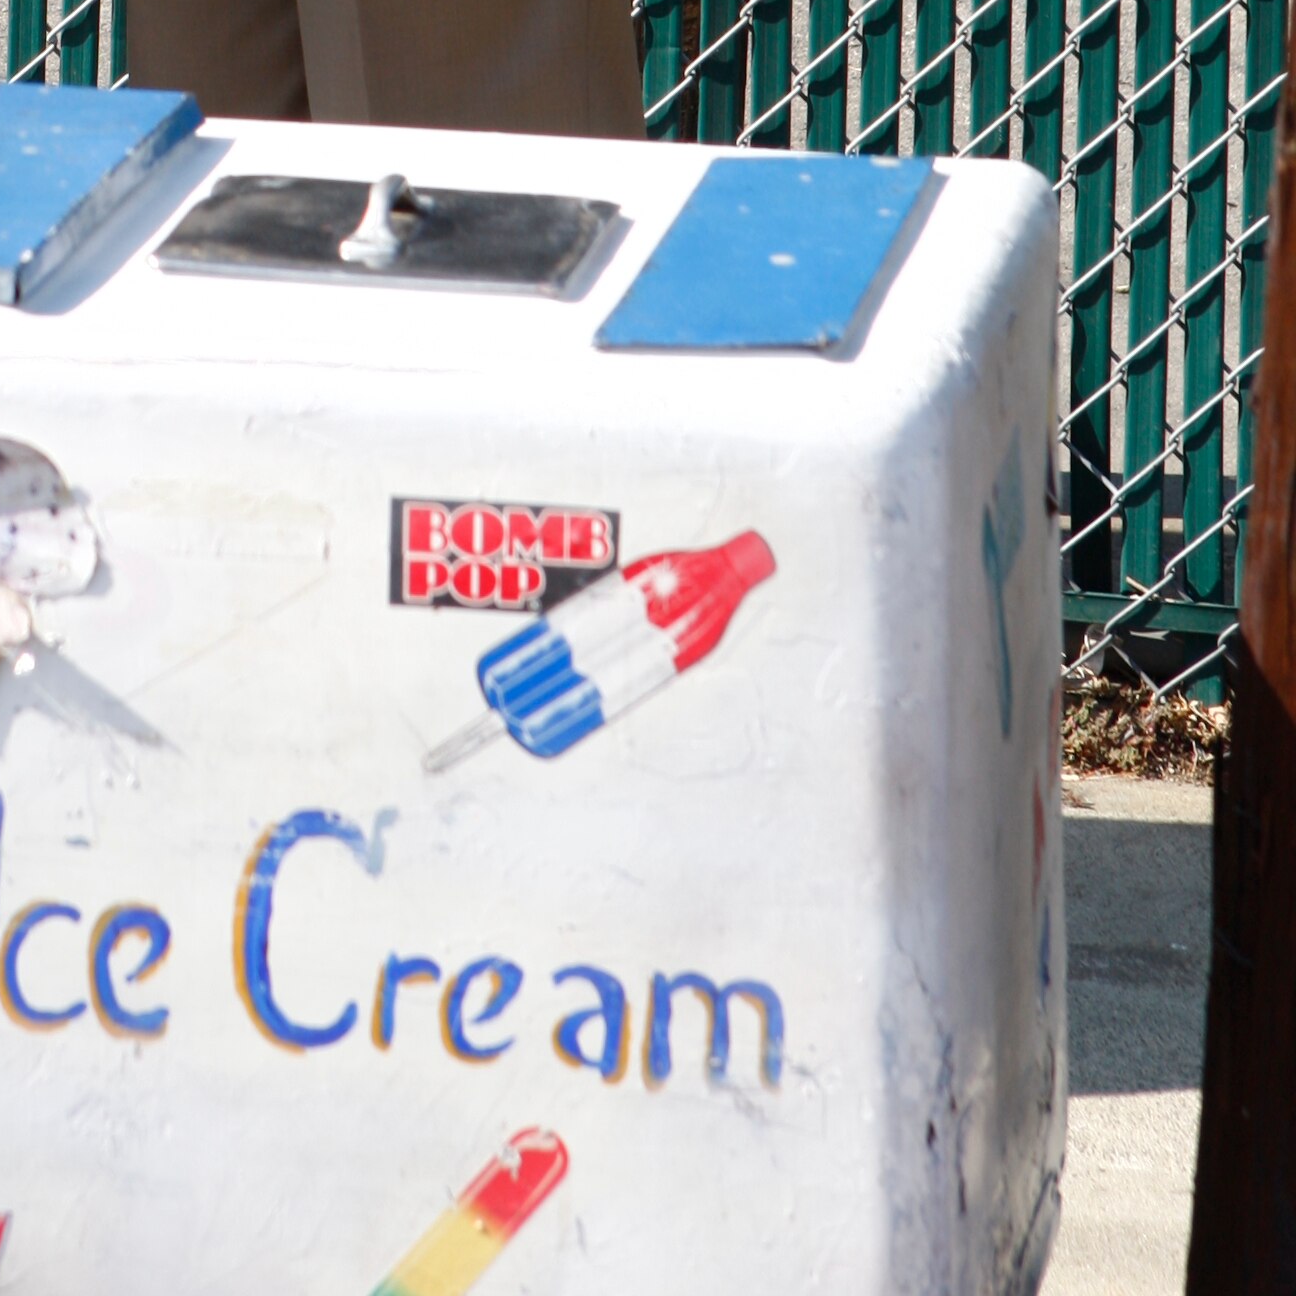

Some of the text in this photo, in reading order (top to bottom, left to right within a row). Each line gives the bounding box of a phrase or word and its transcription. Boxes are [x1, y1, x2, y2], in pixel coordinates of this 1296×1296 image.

[402, 501, 615, 567] BOMB
[402, 556, 546, 610] POP
[232, 807, 786, 1091] Cream
